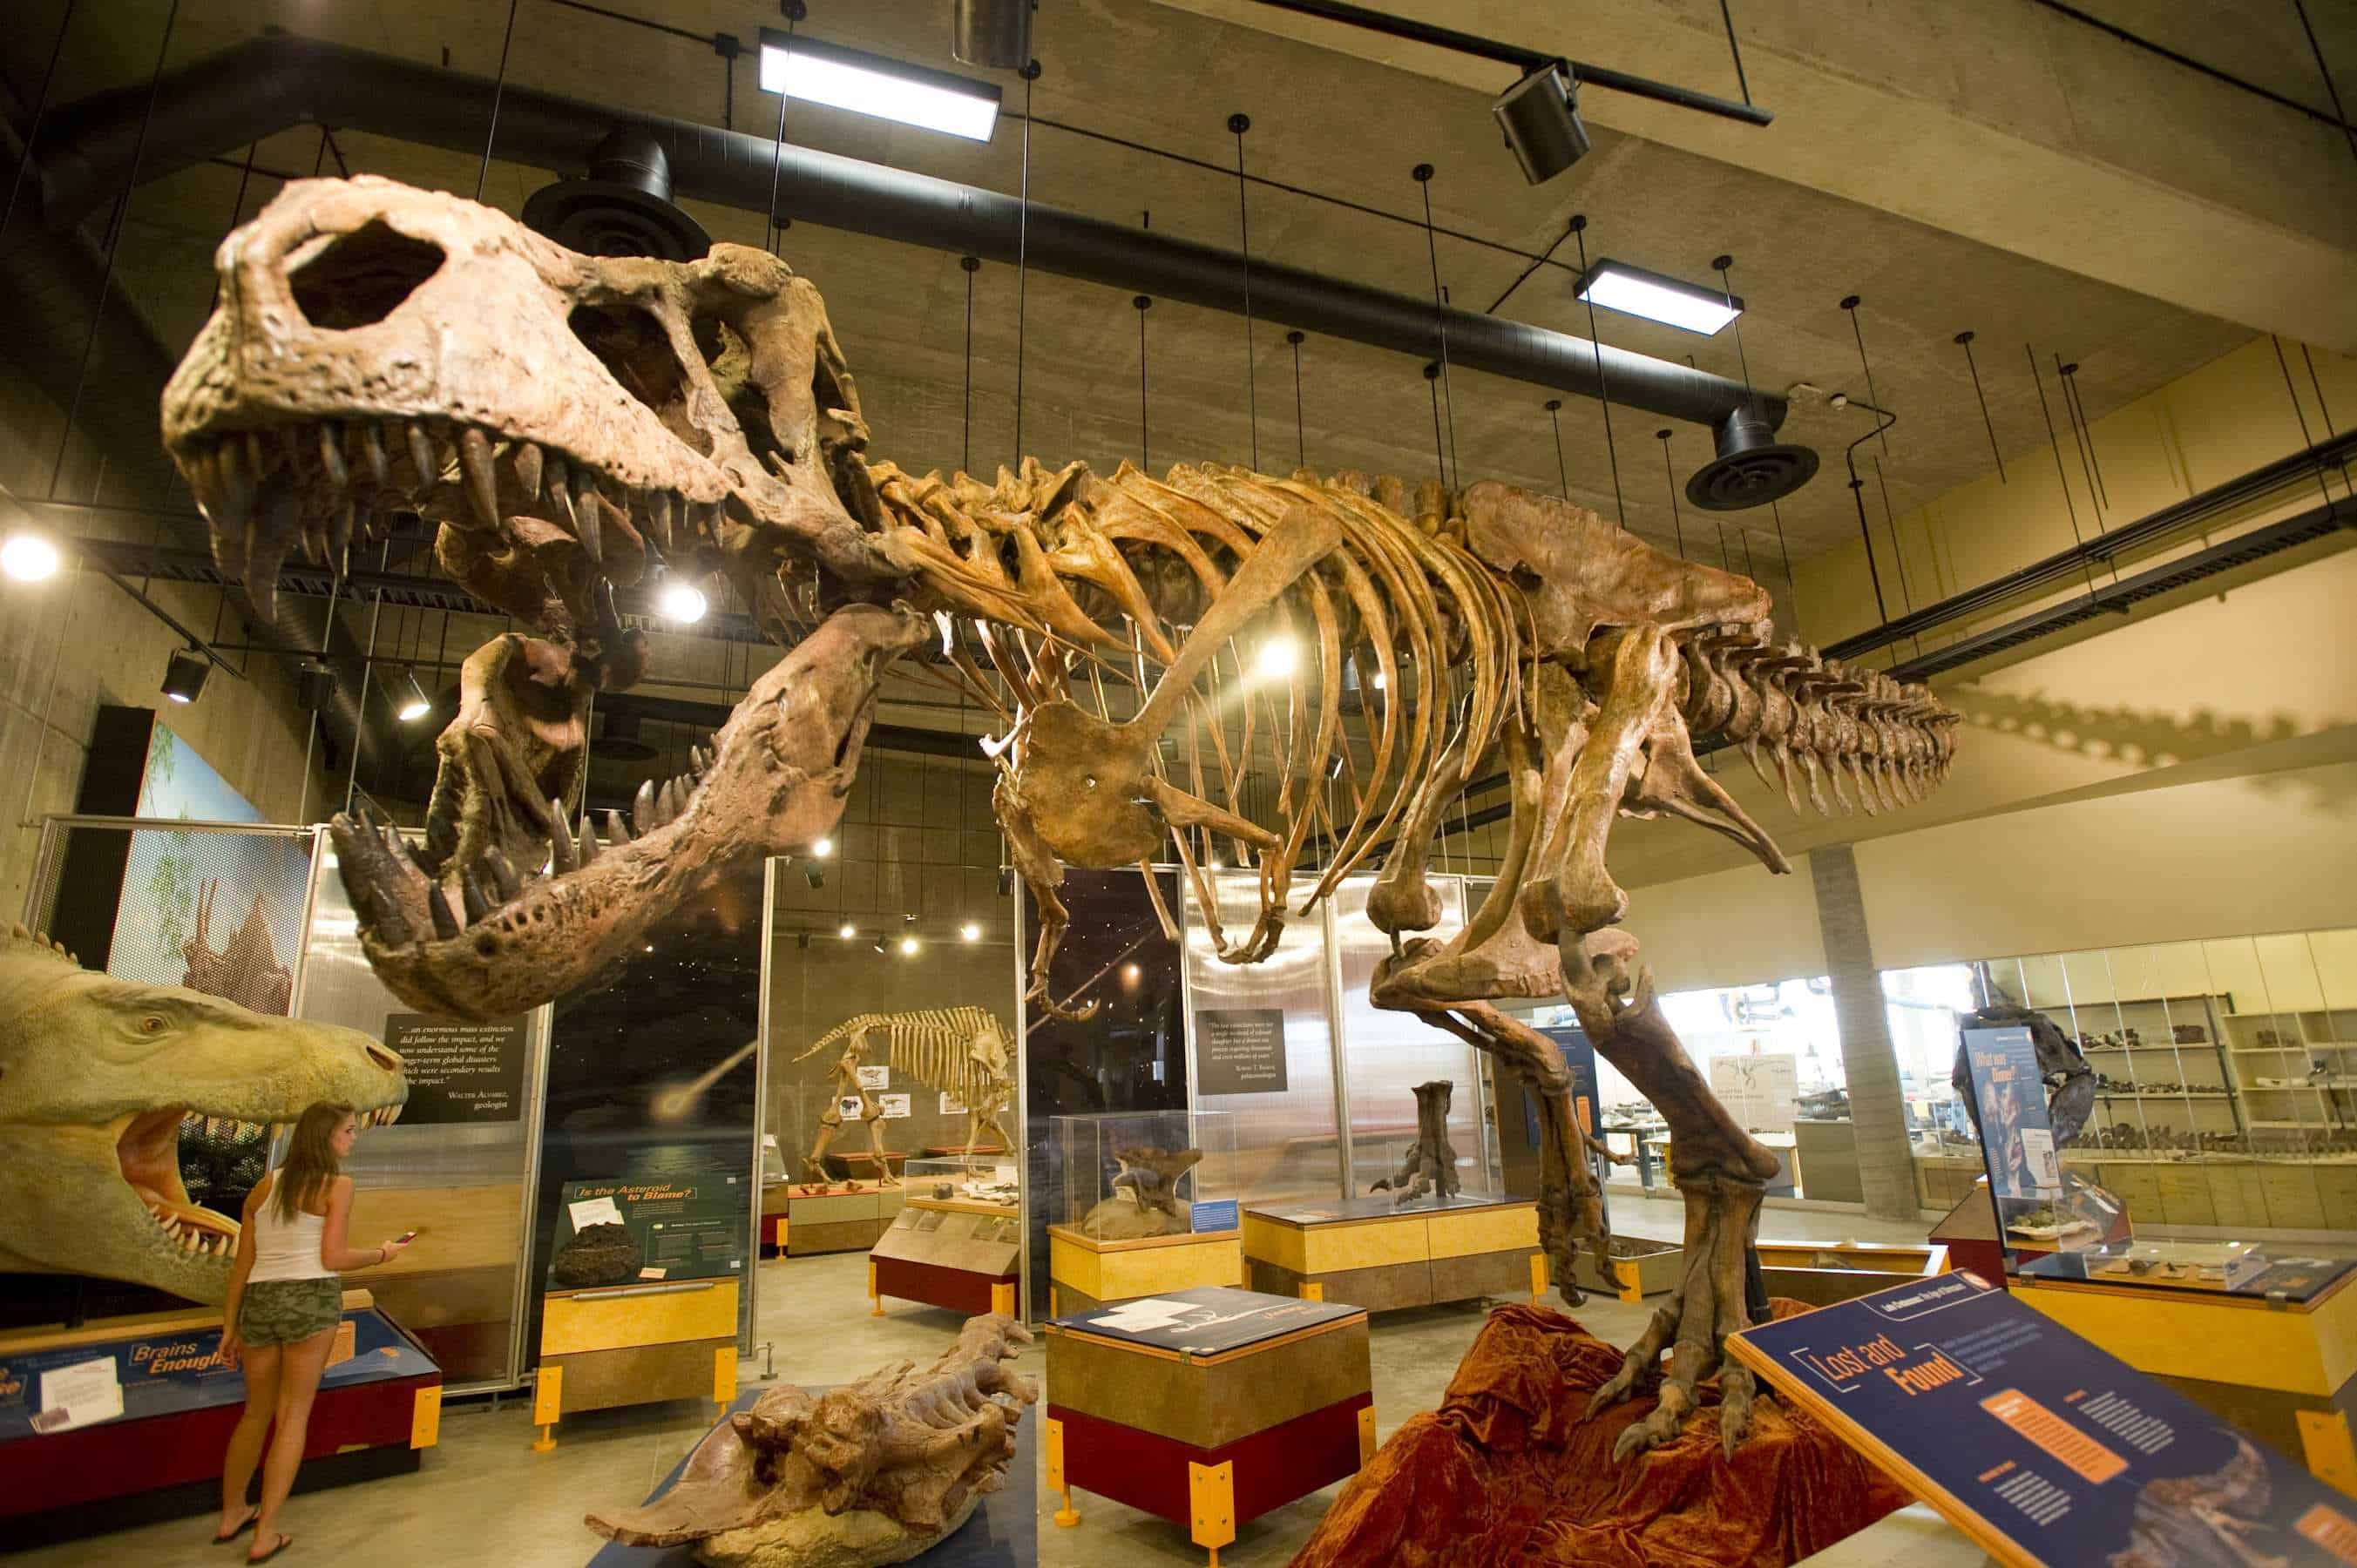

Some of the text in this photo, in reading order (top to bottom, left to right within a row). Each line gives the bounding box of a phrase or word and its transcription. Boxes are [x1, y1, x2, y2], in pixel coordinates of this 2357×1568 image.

[414, 1037, 437, 1045] follow
[451, 1037, 477, 1045] impact,
[478, 1045, 487, 1055] of
[443, 1056, 464, 1066] global
[440, 1065, 476, 1076] secondary
[473, 1100, 508, 1111] geologist
[579, 1183, 672, 1197] Is the Asteroid
[627, 1188, 693, 1201] to Blame?
[133, 1342, 198, 1362] Brains
[1808, 1346, 1873, 1381] Lost
[1860, 1333, 1908, 1366] and
[1883, 1351, 1965, 1396] Found
